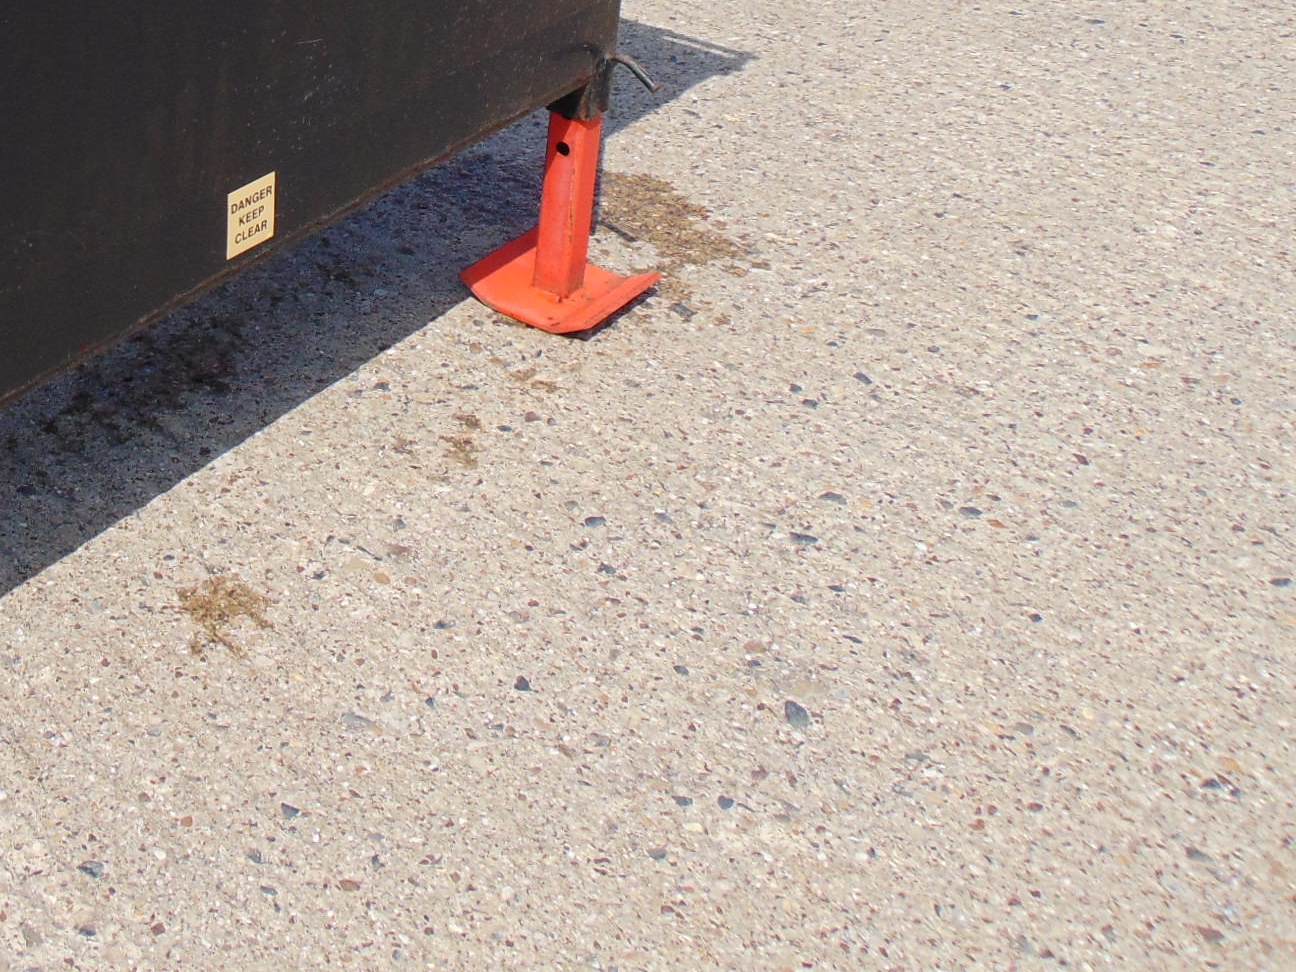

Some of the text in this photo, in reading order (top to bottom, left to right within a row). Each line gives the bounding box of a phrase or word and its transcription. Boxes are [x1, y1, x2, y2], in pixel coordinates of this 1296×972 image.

[231, 185, 272, 214] DANGER
[239, 205, 264, 226] KEEP
[235, 219, 267, 244] CLEAR
